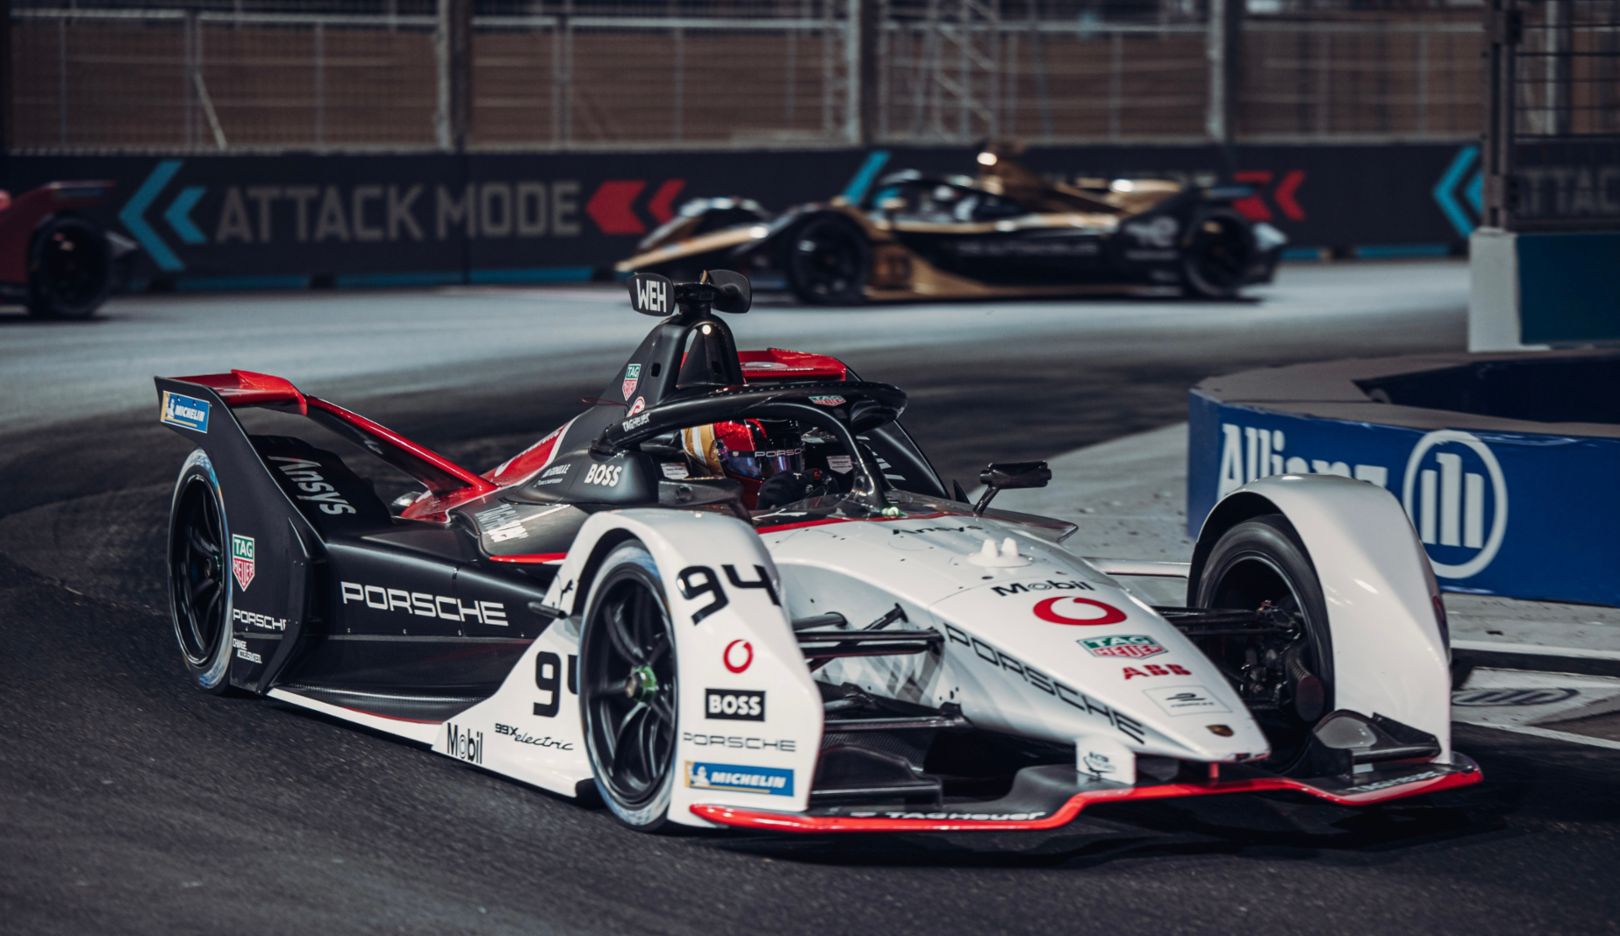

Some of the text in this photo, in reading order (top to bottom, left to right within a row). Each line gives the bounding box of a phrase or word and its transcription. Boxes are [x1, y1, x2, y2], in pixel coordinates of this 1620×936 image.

[216, 181, 580, 243] ATTACK MODE
[636, 279, 667, 313] WEH
[175, 404, 206, 423] MICHELIN
[1217, 423, 1388, 500] Alli
[267, 455, 357, 515] Ansys
[584, 464, 623, 488] BOSS
[234, 539, 253, 558] TAG
[233, 559, 254, 587] HEUER
[675, 564, 783, 627] 94
[990, 579, 1097, 597] Mobil
[340, 581, 509, 627] PORSCHE
[944, 623, 1146, 745] PORSCHE
[1122, 663, 1192, 681] ABB
[708, 694, 762, 716] BOSS
[447, 723, 483, 765] Mobil
[683, 731, 797, 753] PORSCHE
[710, 770, 787, 790] MICHELIN
